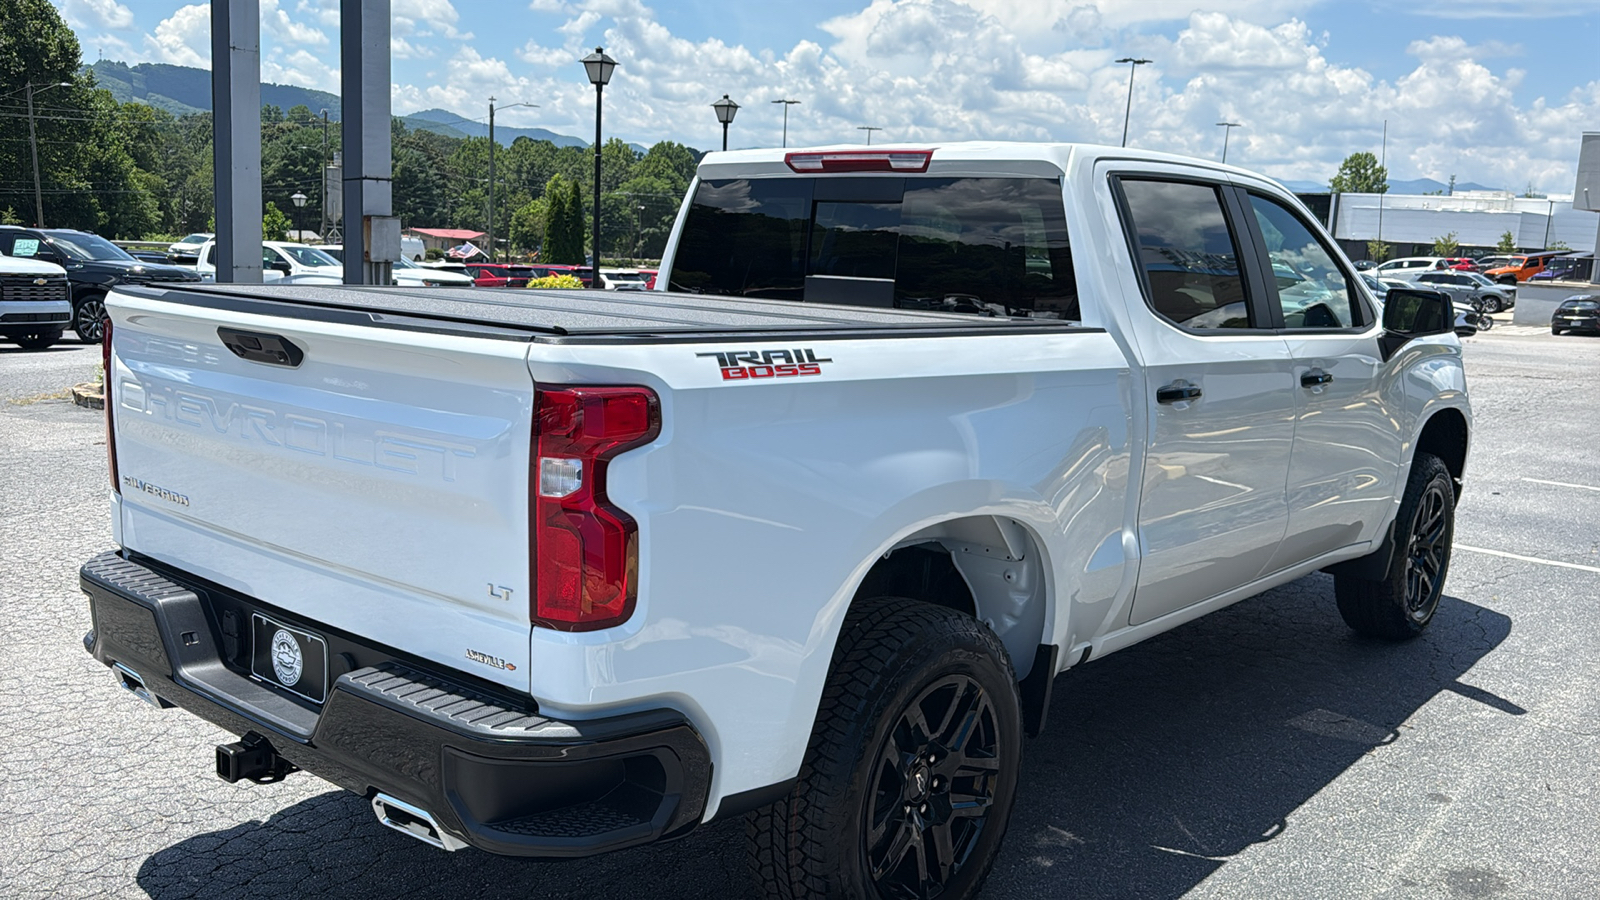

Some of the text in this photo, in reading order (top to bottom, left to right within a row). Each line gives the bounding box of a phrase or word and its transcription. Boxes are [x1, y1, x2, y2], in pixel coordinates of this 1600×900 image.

[694, 348, 833, 367] TRAIL
[720, 363, 821, 381] BOSS
[119, 379, 477, 482] CHEVROLET
[123, 475, 189, 506] SILVERADO
[487, 583, 514, 601] LT
[465, 648, 505, 670] ASHEVILLE
